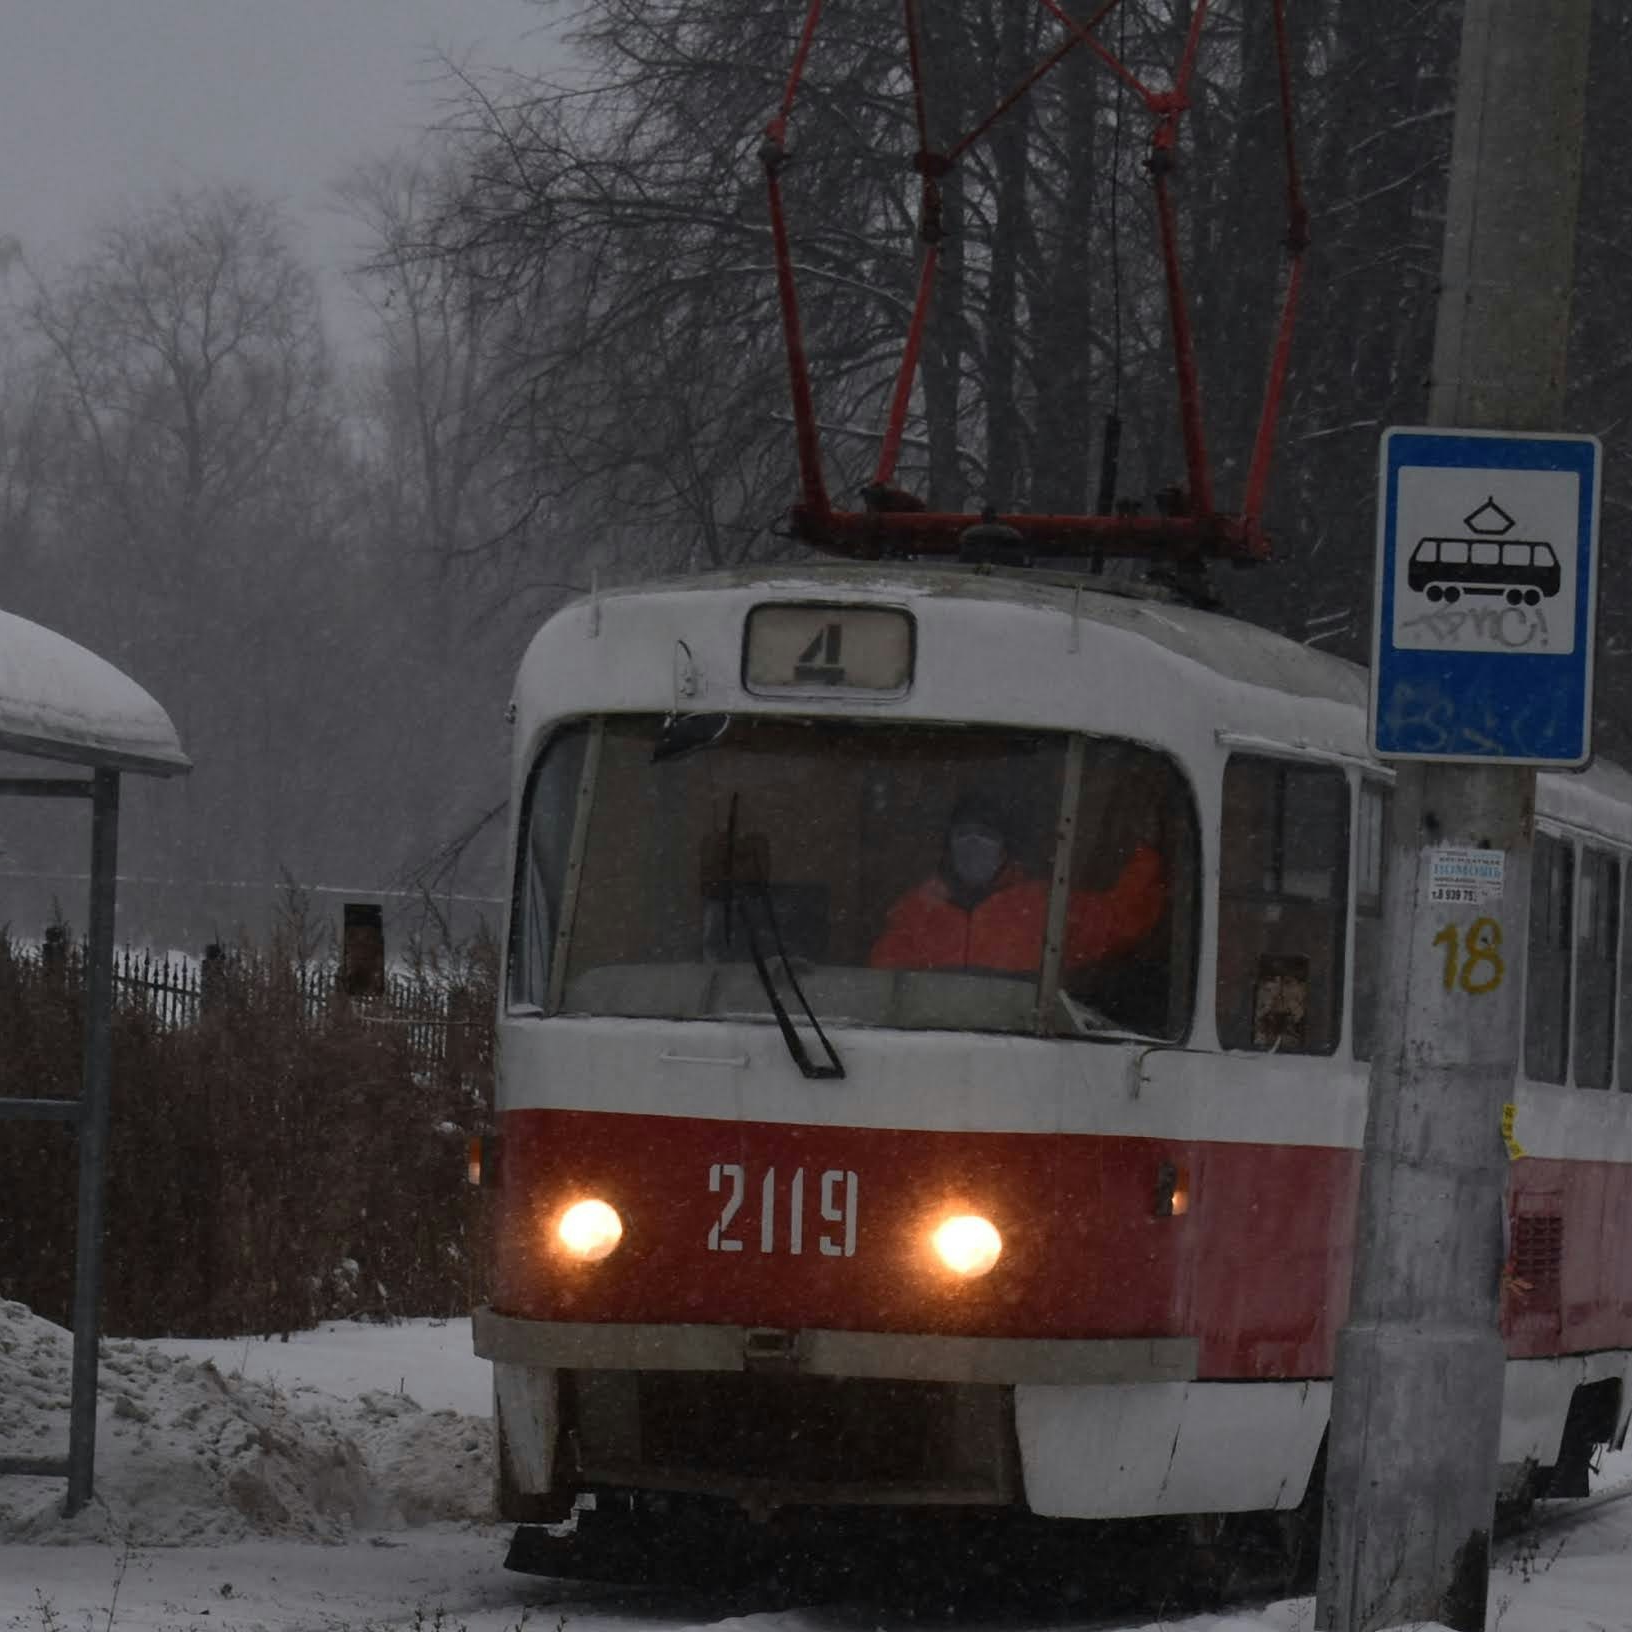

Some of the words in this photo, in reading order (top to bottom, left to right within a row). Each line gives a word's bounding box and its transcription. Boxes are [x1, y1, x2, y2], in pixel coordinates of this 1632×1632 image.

[793, 624, 846, 686] 4
[1431, 917, 1505, 994] 18
[708, 1163, 858, 1258] 2119
